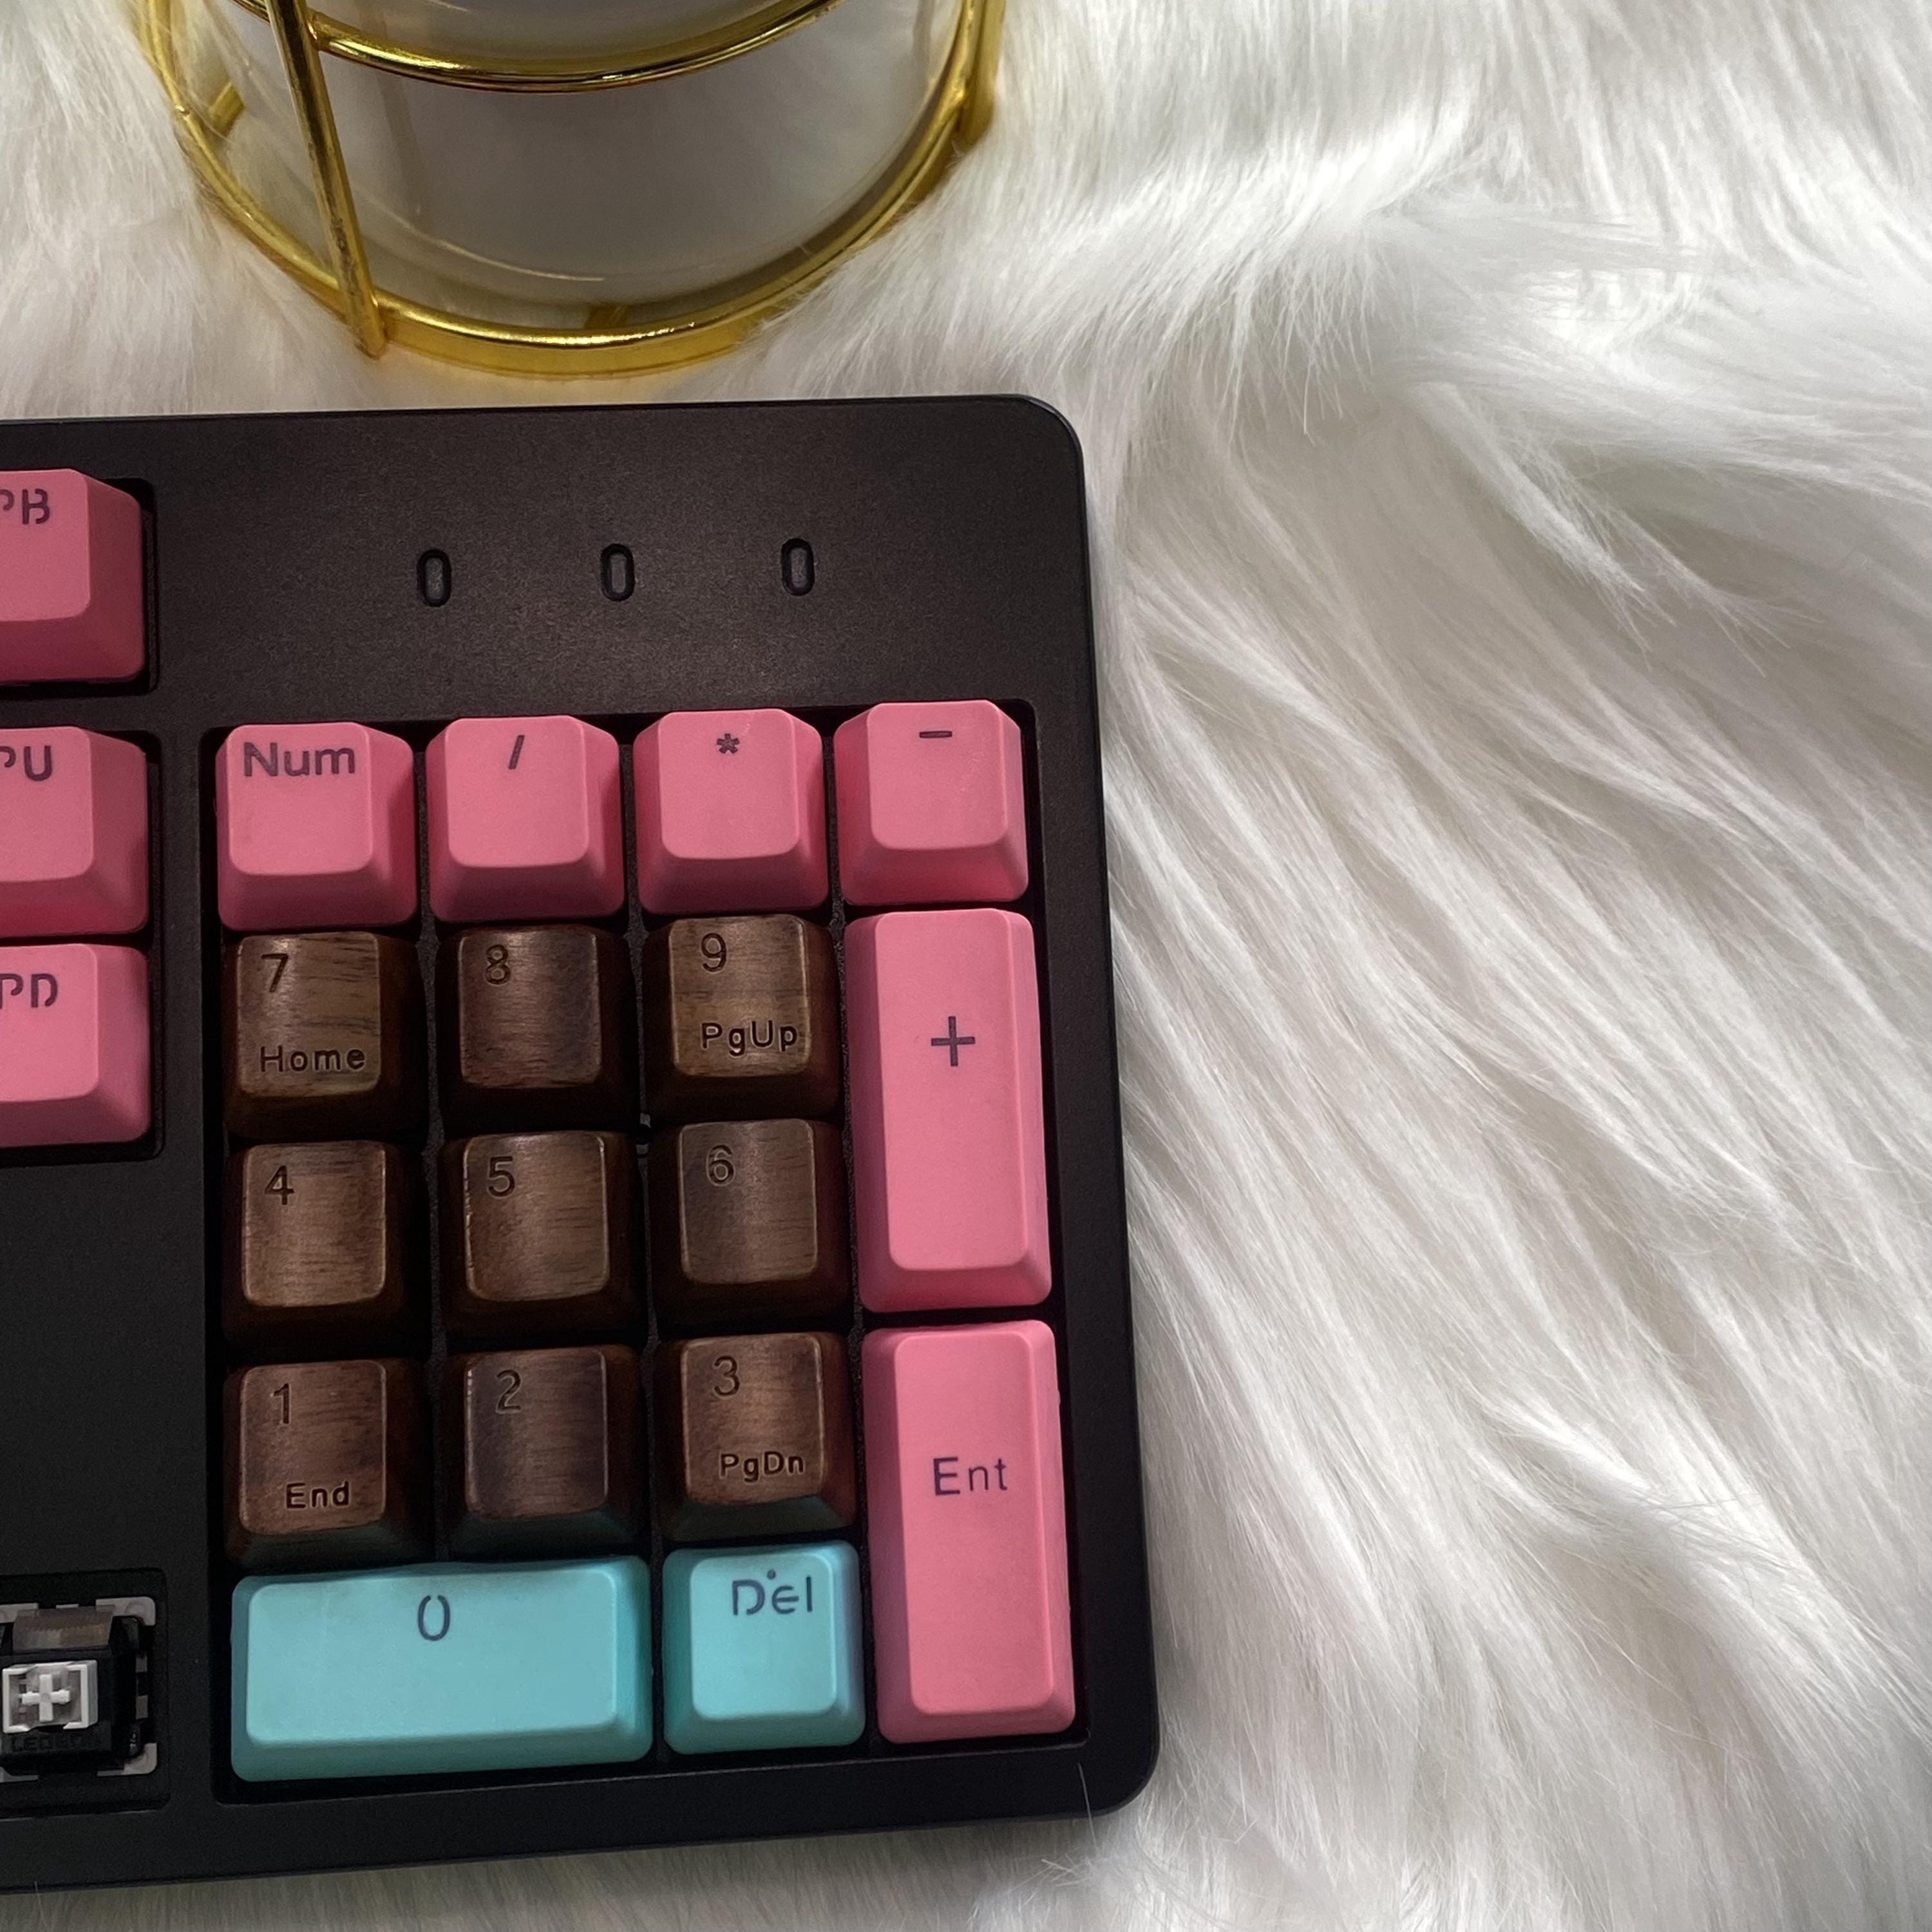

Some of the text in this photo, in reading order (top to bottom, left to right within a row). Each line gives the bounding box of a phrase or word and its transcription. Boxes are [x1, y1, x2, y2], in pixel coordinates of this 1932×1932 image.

[243, 741, 355, 778] Num
[486, 944, 511, 985] 8
[701, 933, 727, 972] 9
[0, 972, 59, 1010] PD
[261, 953, 289, 993] 7
[260, 1045, 366, 1072] Home
[701, 1020, 798, 1057] PgUp
[488, 1157, 515, 1197] 5
[708, 1144, 735, 1186] 6
[264, 1165, 294, 1206] 4
[496, 1369, 521, 1414] 2
[714, 1356, 741, 1397] 3
[272, 1383, 290, 1425] 1
[720, 1451, 804, 1483] PgDn
[933, 1456, 1008, 1496] Ent
[286, 1481, 350, 1510] End
[732, 1575, 814, 1616] Del
[417, 1594, 451, 1642] 0
